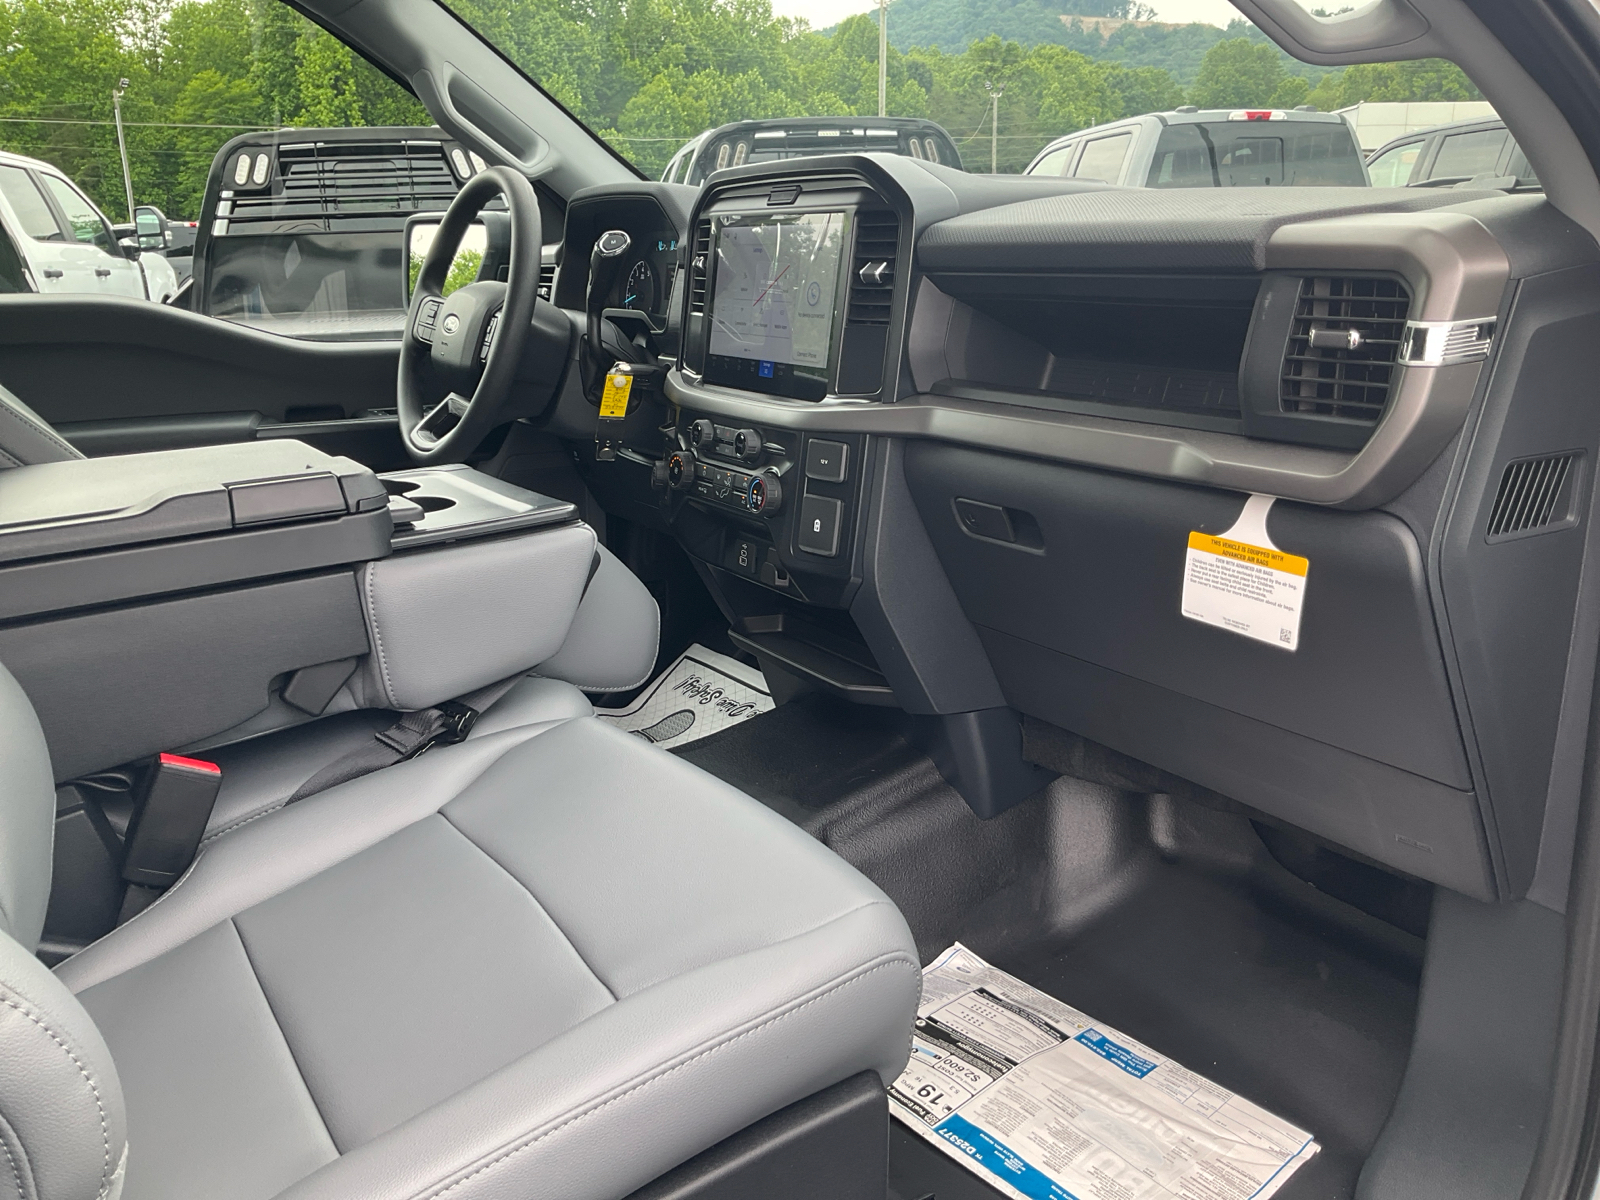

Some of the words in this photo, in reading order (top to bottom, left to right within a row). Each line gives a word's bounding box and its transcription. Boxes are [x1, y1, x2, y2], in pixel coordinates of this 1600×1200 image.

[1211, 539, 1221, 547] THIS
[1223, 542, 1240, 552] VEHICLE
[1247, 548, 1270, 559] EQUIPPED
[1271, 554, 1284, 562] WITH
[1222, 550, 1246, 561] ADVANCED
[1256, 558, 1269, 566] BAGS
[1192, 558, 1207, 566] Children
[1236, 563, 1255, 572] ADVANCED
[673, 677, 723, 704] Safely!
[937, 1064, 955, 1076] cost
[943, 1057, 981, 1082] $2,600
[1125, 1066, 1141, 1076] TOTAL
[900, 1079, 916, 1090] MPG
[890, 1088, 914, 1105] Economy
[916, 1083, 945, 1106] 19
[912, 1103, 926, 1115] Fuel
[938, 1127, 977, 1155] D25377
